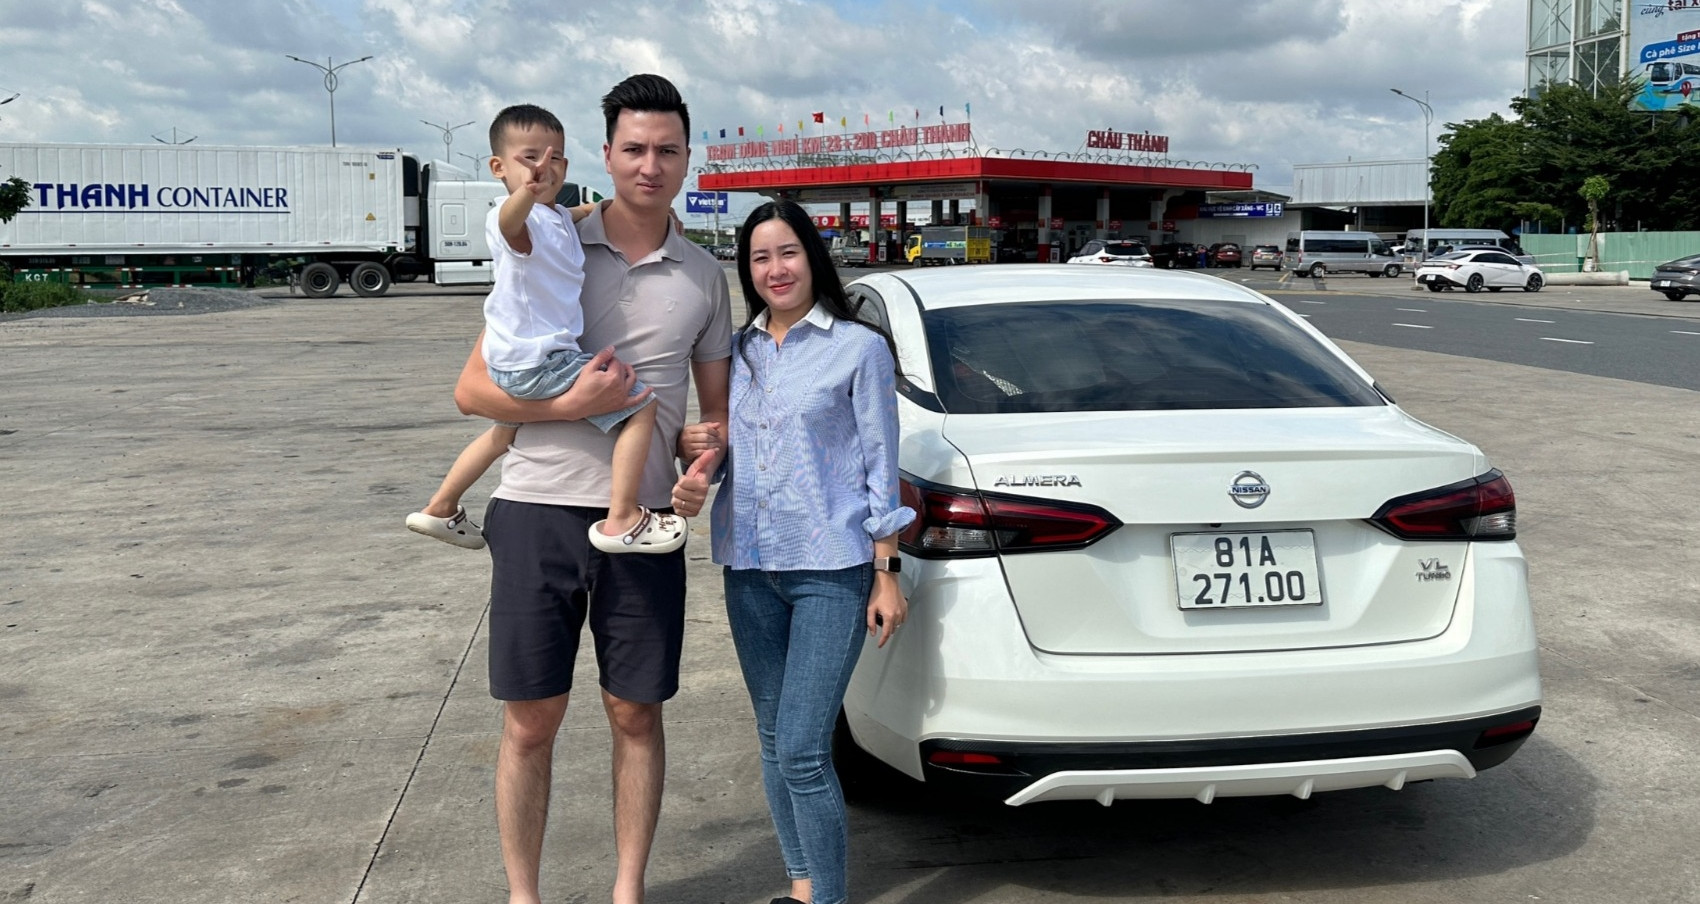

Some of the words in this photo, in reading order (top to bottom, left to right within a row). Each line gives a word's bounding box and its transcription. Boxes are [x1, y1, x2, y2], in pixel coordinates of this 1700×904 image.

[1645, 51, 1657, 59] Cà
[1659, 47, 1676, 58] phê
[1678, 44, 1696, 53] Size
[802, 136, 822, 154] KM
[881, 125, 918, 148] CHÂU
[923, 121, 970, 145] THÀNH
[1088, 128, 1122, 149] CHÂU
[1127, 130, 1168, 152] THÀNH
[33, 184, 149, 210] THANH
[157, 187, 288, 208] CONTAINER
[25, 273, 48, 283] KCT
[994, 474, 1082, 488] ALMERA
[1232, 486, 1267, 495] NISSAN
[1214, 536, 1277, 567] 81A
[1418, 557, 1449, 571] VL
[1193, 570, 1305, 605] 271.00
